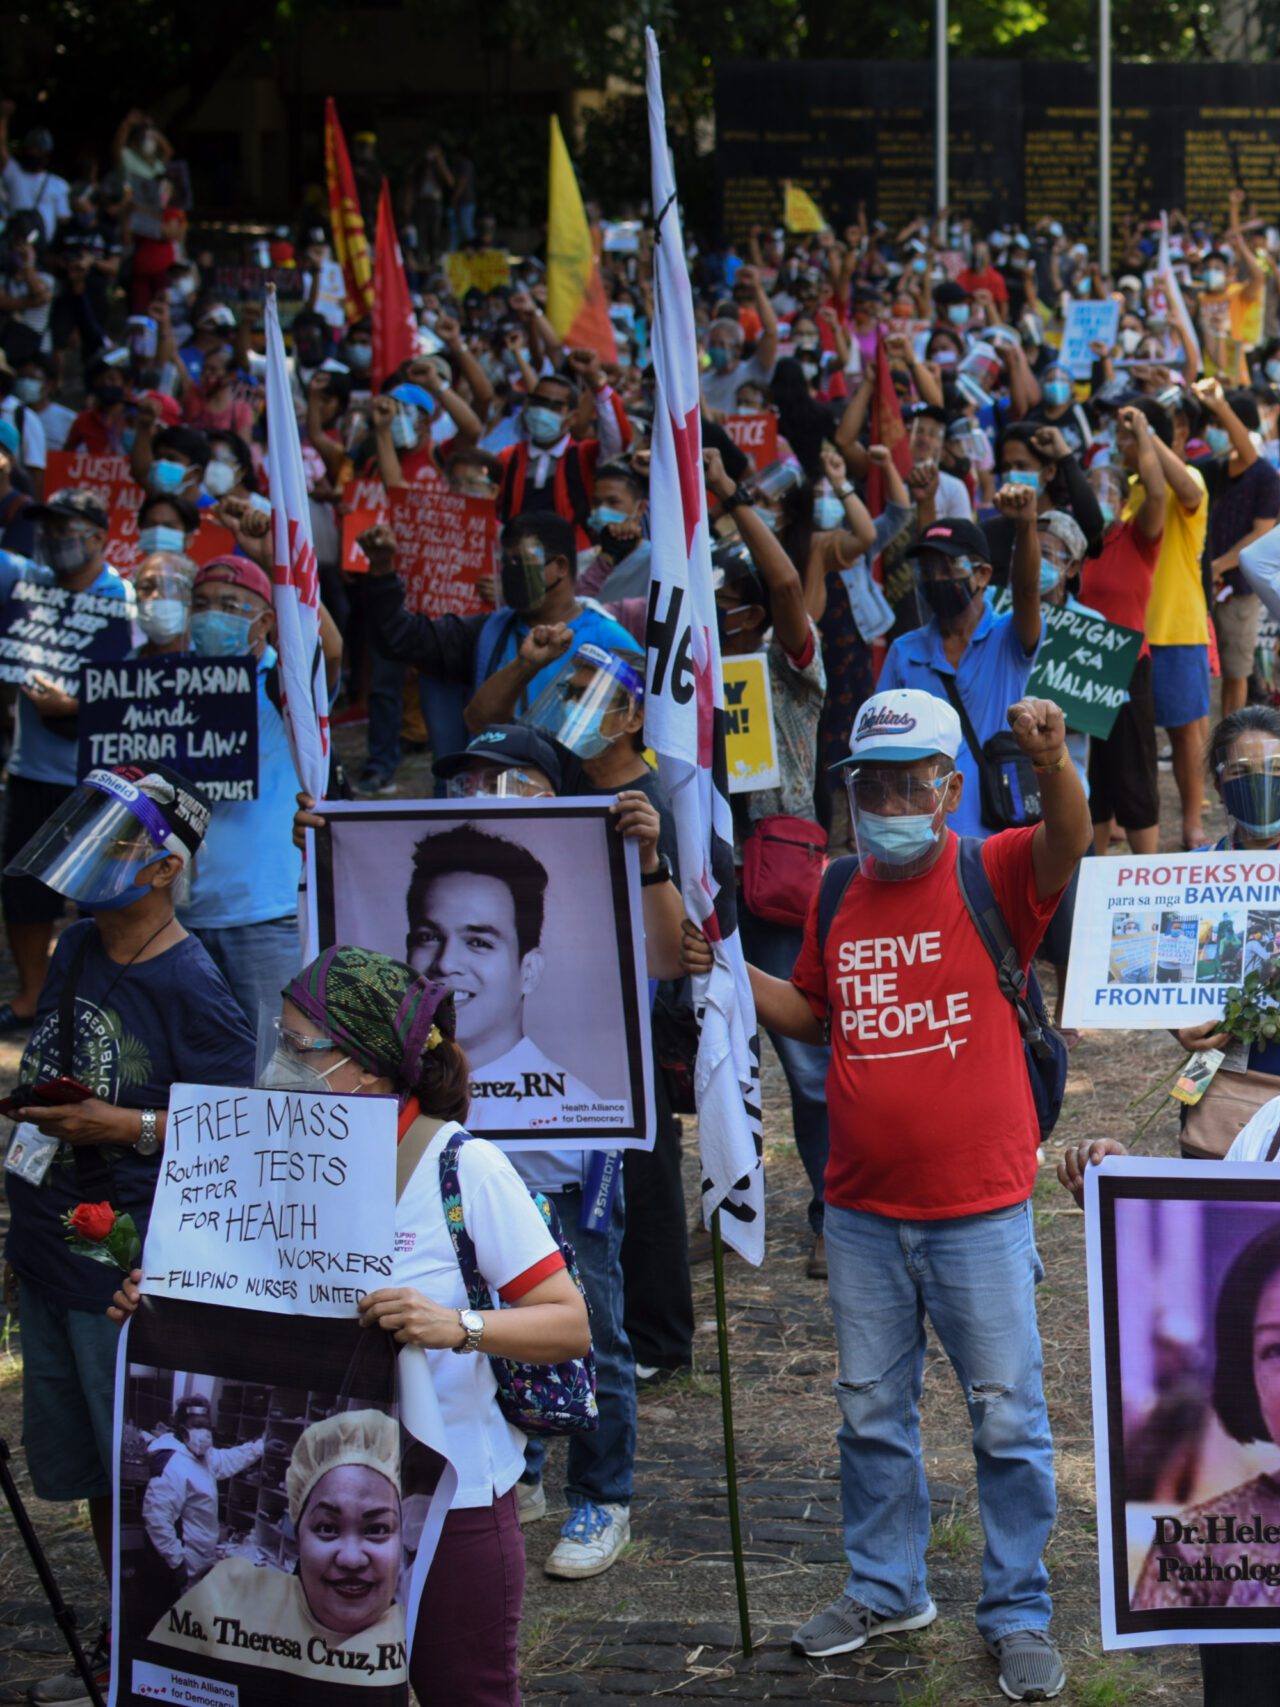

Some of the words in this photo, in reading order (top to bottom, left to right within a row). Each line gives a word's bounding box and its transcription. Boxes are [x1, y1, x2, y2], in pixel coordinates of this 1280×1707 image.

[86, 666, 252, 703] BALIK-PASADA
[1038, 658, 1125, 708] MALAYAO
[725, 709, 750, 735] N!
[89, 732, 177, 765] TERROR
[187, 730, 247, 759] LAW!
[99, 773, 135, 798] Shield
[1108, 897, 1135, 909] para
[1138, 896, 1150, 905] sa
[1155, 896, 1180, 908] mga
[837, 931, 942, 973] SERVE
[837, 973, 899, 1007] THE
[841, 992, 972, 1041] PEOPLE
[470, 1072, 566, 1102] erez,RN
[173, 1096, 250, 1150] FREE
[267, 1096, 349, 1141] MASS
[562, 1104, 589, 1112] Health
[591, 1103, 625, 1112] Alliance
[562, 1115, 574, 1123] for
[576, 1115, 624, 1124] Democracy
[165, 1153, 230, 1186] Routine
[254, 1150, 347, 1187] TESTS
[597, 1150, 618, 1207] STAEDT
[179, 1211, 220, 1232] FOR
[226, 1201, 317, 1243] HEALTH
[278, 1248, 393, 1276] WORKERS
[246, 1277, 298, 1300] NURSES
[168, 1607, 208, 1642] Ma.
[213, 1615, 302, 1661] Theresa
[171, 1673, 199, 1688] Health
[200, 1679, 235, 1698] Alliance
[171, 1688, 182, 1699] for
